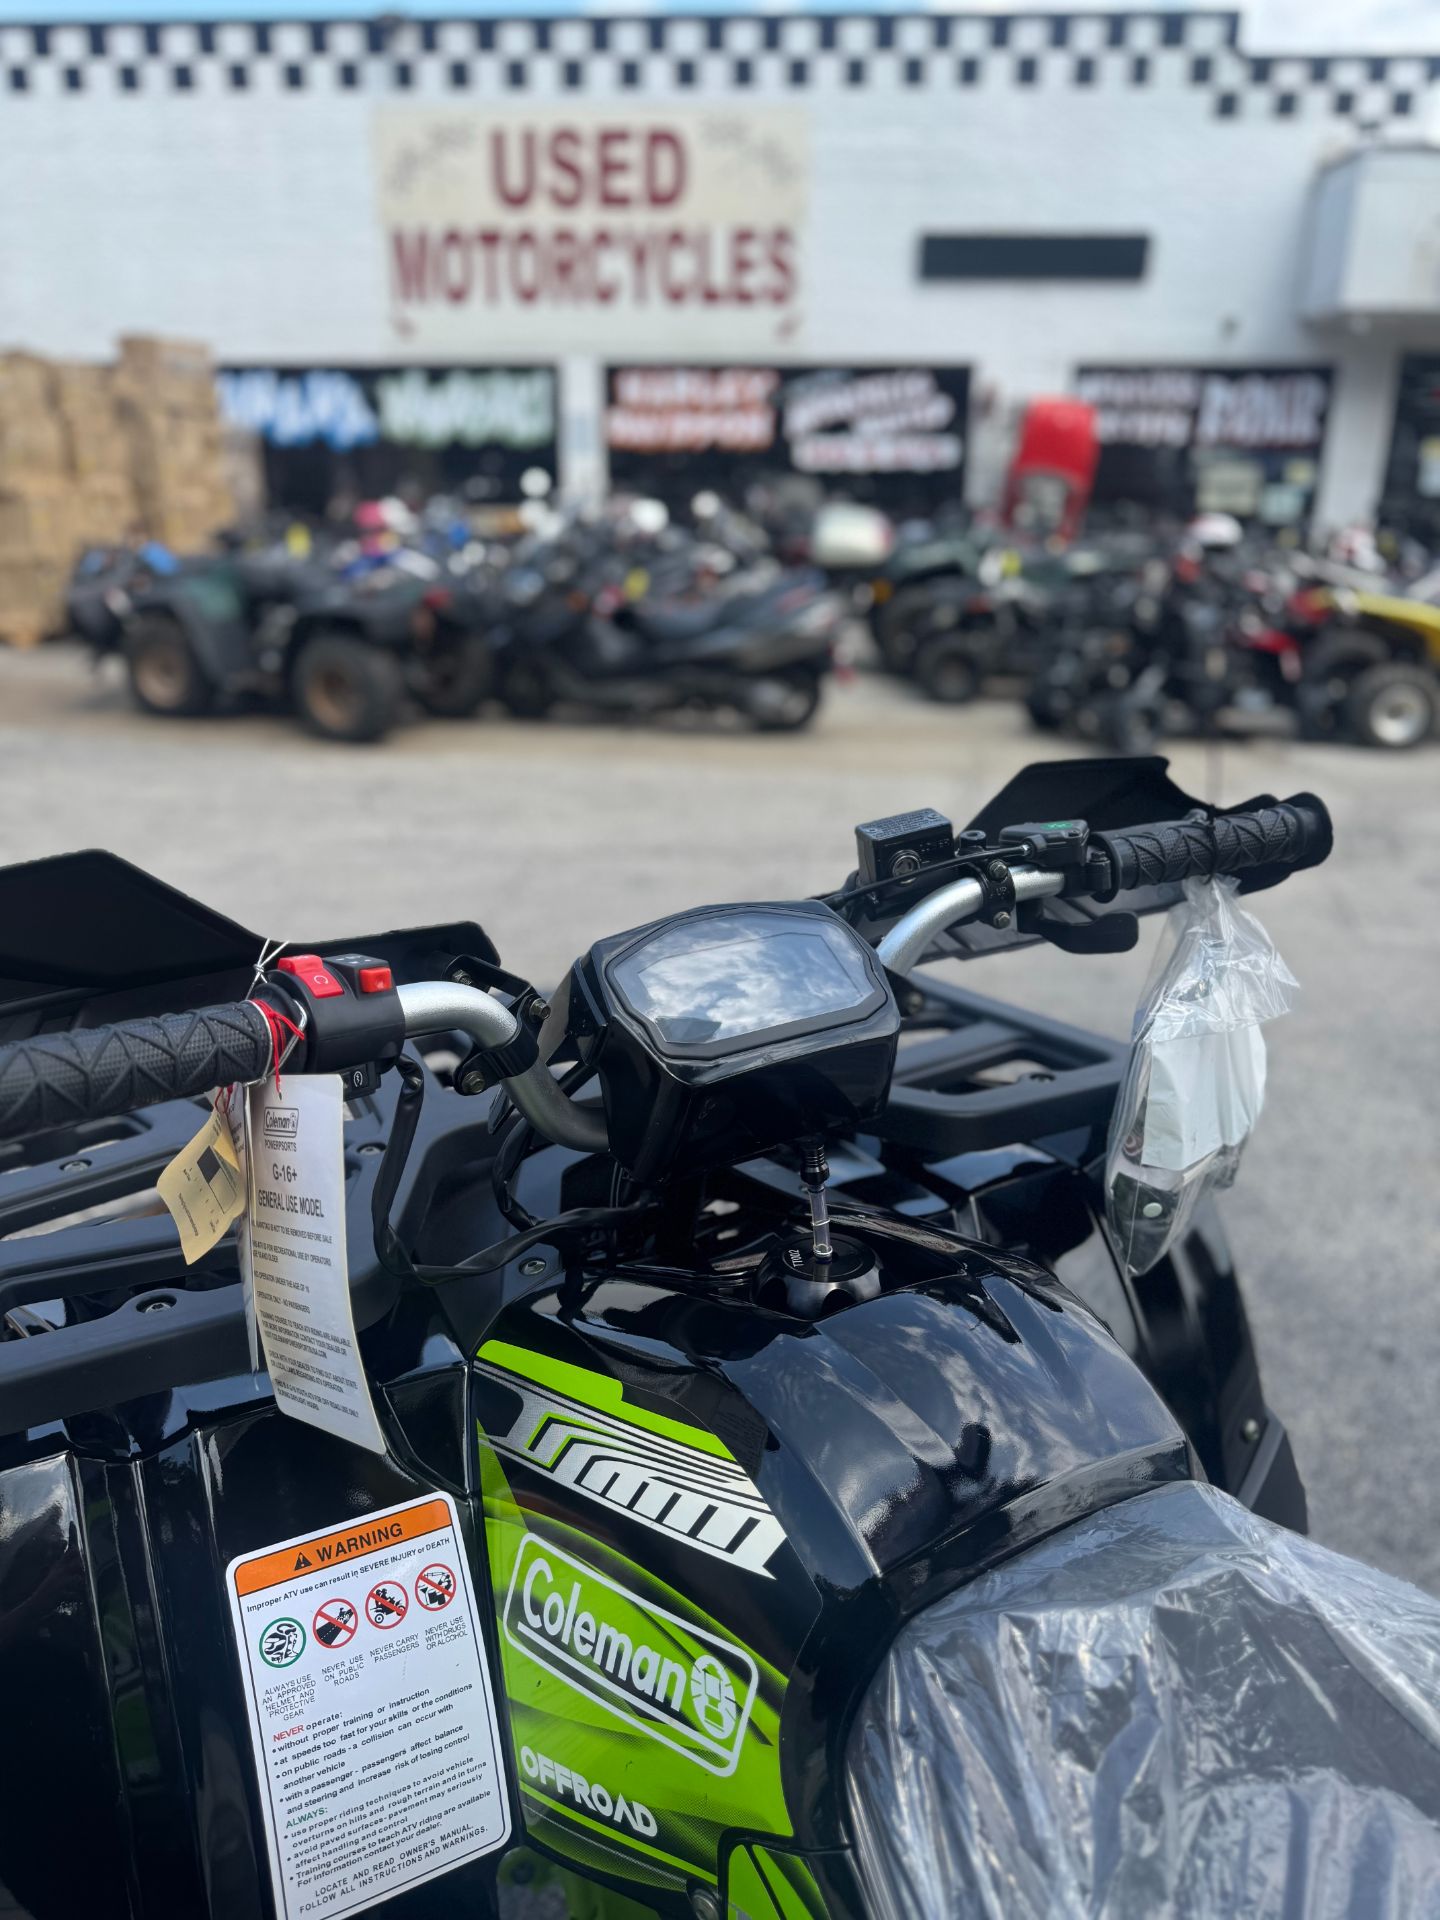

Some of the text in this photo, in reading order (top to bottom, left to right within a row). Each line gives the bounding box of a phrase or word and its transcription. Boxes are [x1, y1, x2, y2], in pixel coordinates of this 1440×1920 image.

[490, 127, 688, 210] USED
[391, 227, 799, 303] MOTORCYCLES
[265, 1109, 291, 1129] Coleman
[272, 1163, 298, 1183] G-16+
[258, 1189, 325, 1218] GENERAL USE MODEL
[316, 1522, 402, 1561] WARNING
[246, 1537, 450, 1612] Improper ATV use can result in SEVERE INJURY or DEATH
[424, 1615, 464, 1636] NEVER USE
[424, 1621, 466, 1643] WITH DRUGS
[425, 1629, 468, 1651] OR ALCOHOL
[523, 1558, 686, 1713] Coleman
[369, 1632, 419, 1657] NEVER CARRY
[373, 1640, 420, 1663] PASSENGERS
[321, 1653, 364, 1675] NEVER USE
[323, 1661, 365, 1682] ON PUBLIC
[333, 1671, 360, 1687] ROADS
[261, 1679, 316, 1706] AN APPROVED
[264, 1673, 312, 1696] ALWAYS USE
[265, 1688, 315, 1712] HELMET AND
[268, 1695, 315, 1718] PROTECTIVE
[277, 1688, 430, 1752] without proper training or instruction
[279, 1683, 473, 1765] at speeds too fast for your skills or the conditions
[282, 1708, 305, 1721] GEAR
[272, 1711, 343, 1742] NEVER operate:
[281, 1768, 293, 1777] on
[293, 1758, 320, 1774] public
[323, 1747, 347, 1761] roads
[360, 1728, 394, 1746] collision
[397, 1721, 412, 1731] can
[414, 1710, 436, 1724] occur
[436, 1703, 454, 1714] with
[283, 1761, 346, 1790] another vehicle
[284, 1790, 303, 1802] with
[310, 1770, 353, 1794] passenger
[361, 1748, 407, 1773] passengers
[410, 1737, 432, 1752] affect
[434, 1724, 463, 1741] balance
[286, 1732, 470, 1815] and steering and increase risk of losing control
[290, 1827, 307, 1838] use
[308, 1814, 337, 1832] proper
[338, 1803, 365, 1819] riding
[365, 1784, 412, 1807] techniques
[422, 1768, 445, 1783] avoid
[445, 1756, 474, 1772] vehicle
[292, 1761, 487, 1848] overturns on hills and rough terrain and in turns
[520, 1745, 658, 1837] OFFROAD
[285, 1807, 328, 1829] ALWAYS:
[293, 1843, 318, 1859] avoid
[319, 1831, 346, 1850] paved
[388, 1797, 428, 1820] pavement
[428, 1790, 446, 1801] may
[446, 1773, 483, 1793] seriously
[295, 1790, 491, 1882] Training courses to teach ATV riding are available
[295, 1815, 408, 1869] affect handling and control
[296, 1817, 442, 1888] For information contact your dealer.
[299, 1825, 488, 1914] FOLLOW ALL INSTRUCTIONS AND WARNINGS.
[314, 1823, 473, 1897] LOCATE AND READ OWNER'S MANUAL.
